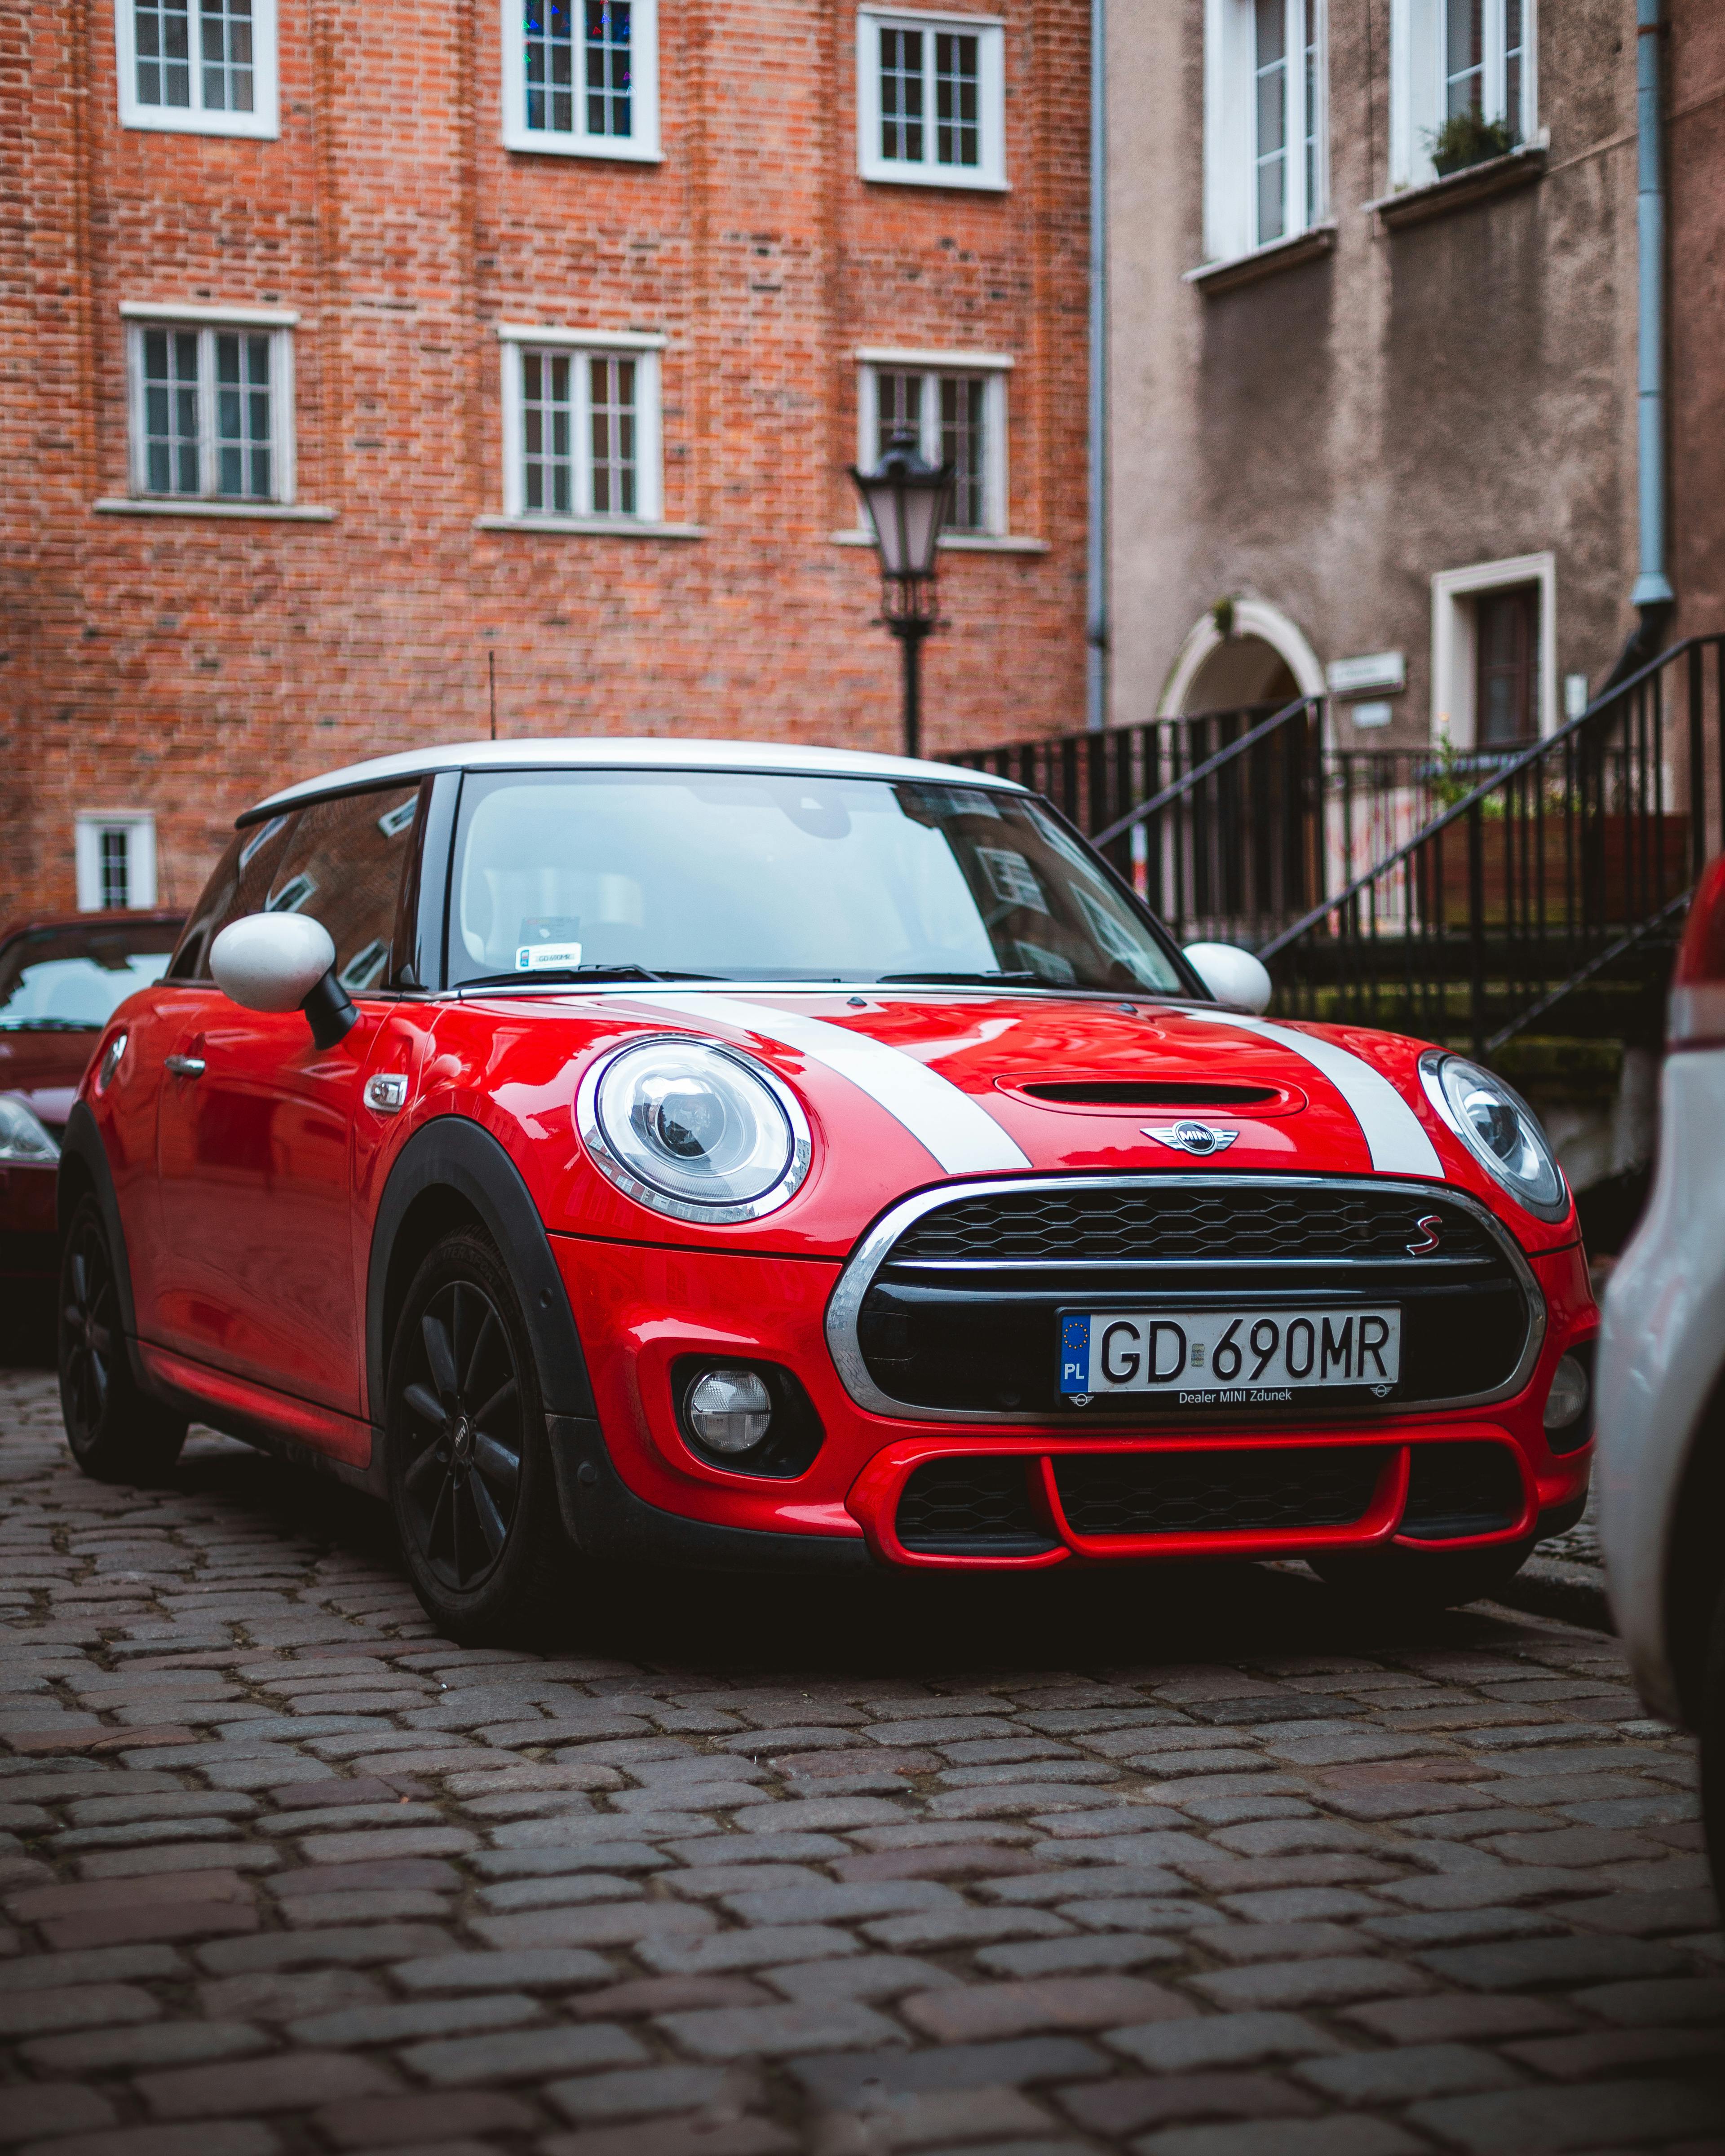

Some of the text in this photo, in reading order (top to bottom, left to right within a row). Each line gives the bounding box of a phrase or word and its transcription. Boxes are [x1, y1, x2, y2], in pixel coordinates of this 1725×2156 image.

[1178, 1131, 1212, 1141] MINI
[1406, 1215, 1442, 1256] S
[1101, 1315, 1389, 1383] GD 690MR
[1064, 1363, 1084, 1380] PL
[1179, 1388, 1292, 1403] Dealer MINI Zdunek
[454, 1424, 466, 1448] MINI
